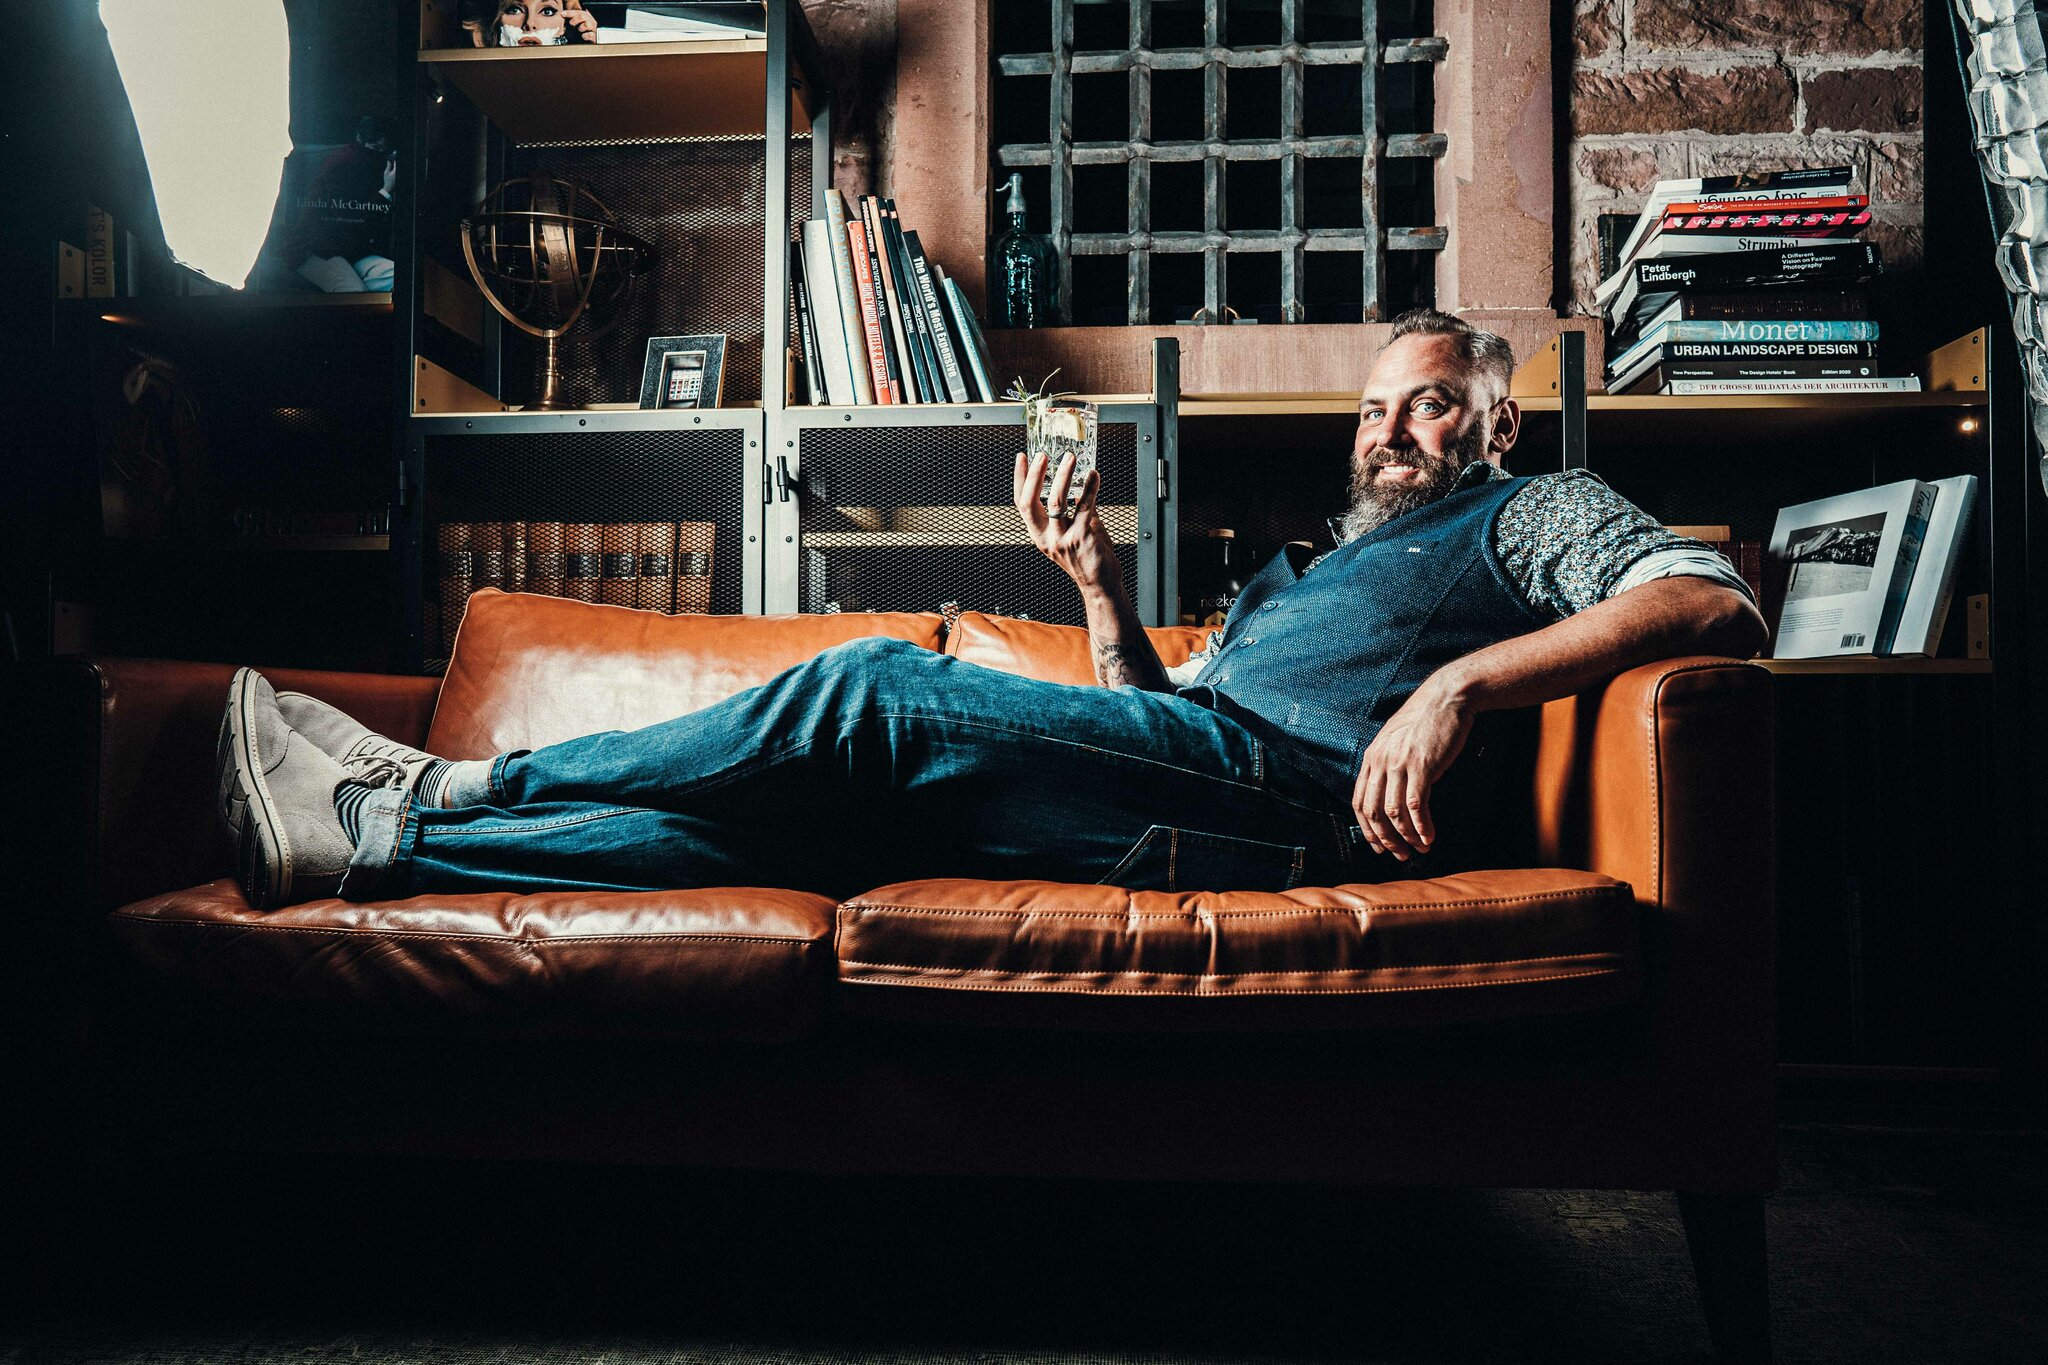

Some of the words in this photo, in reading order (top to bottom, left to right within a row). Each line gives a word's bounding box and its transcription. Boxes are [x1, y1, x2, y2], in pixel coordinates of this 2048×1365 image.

[297, 198, 327, 208] Linda
[330, 199, 391, 214] McCartney
[91, 240, 107, 285] KOLOR
[912, 256, 927, 273] The
[1641, 263, 1670, 273] Peter
[1782, 262, 1822, 270] Photography
[870, 257, 883, 299] MIDDLEHURST
[1641, 269, 1697, 283] Lindbergh
[918, 274, 937, 308] World's
[860, 281, 877, 324] HONEYMOON
[877, 299, 885, 317] TONY
[929, 308, 945, 332] Most
[1720, 320, 1809, 341] Monet
[867, 324, 881, 351] HOTELS
[935, 332, 957, 377] Expensive
[1673, 345, 1720, 356] URBAN
[1723, 344, 1805, 356] LANDSCAPE
[1808, 344, 1859, 355] DESIGN
[872, 357, 887, 389] RESORTS
[1719, 383, 1753, 391] GROSSE
[1825, 382, 1889, 390] ARCHITEKTUR
